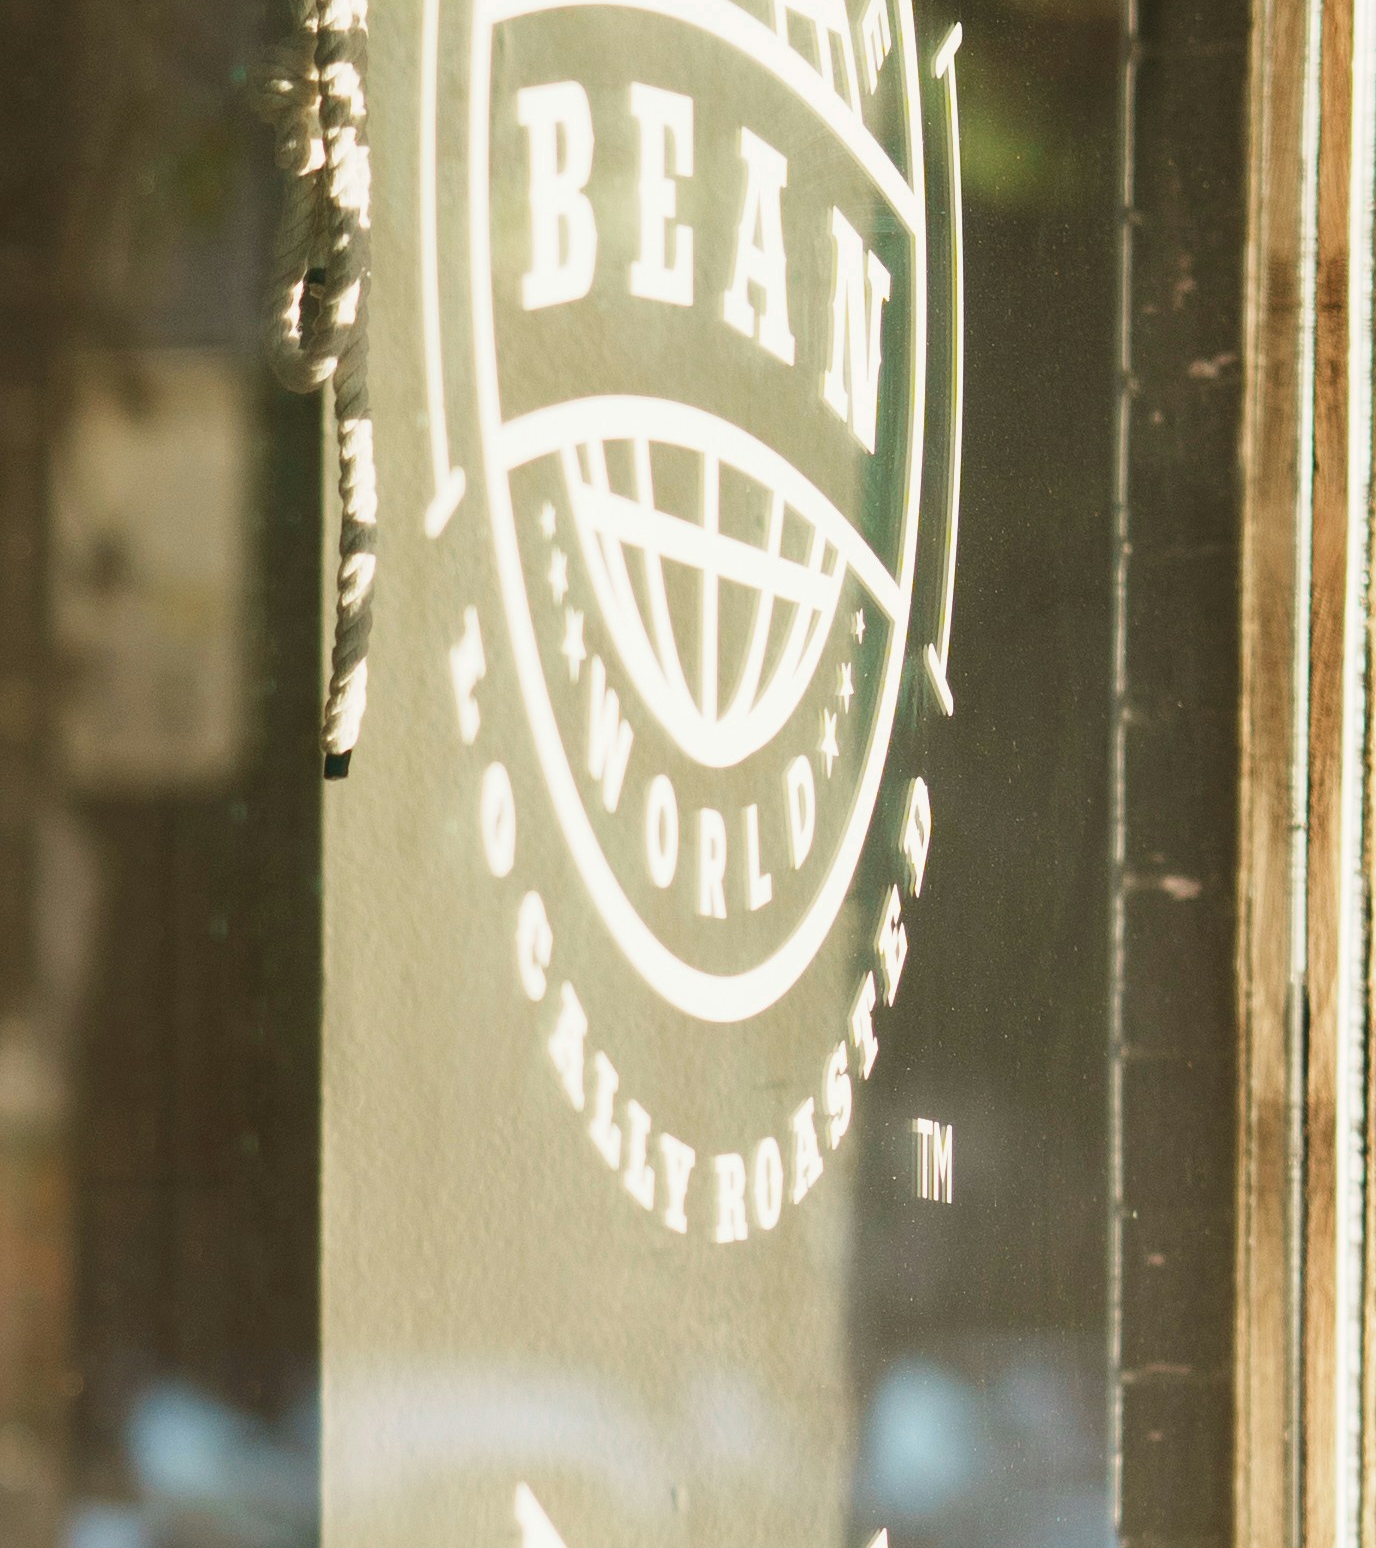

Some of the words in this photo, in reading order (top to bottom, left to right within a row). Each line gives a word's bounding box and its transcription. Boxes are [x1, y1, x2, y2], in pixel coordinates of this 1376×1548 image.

[516, 80, 892, 455] BEAN
[450, 606, 695, 1234] LOCALLY
[714, 776, 932, 1244] ROASTED
[587, 655, 817, 920] WORLD
[914, 1117, 954, 1204] TM
